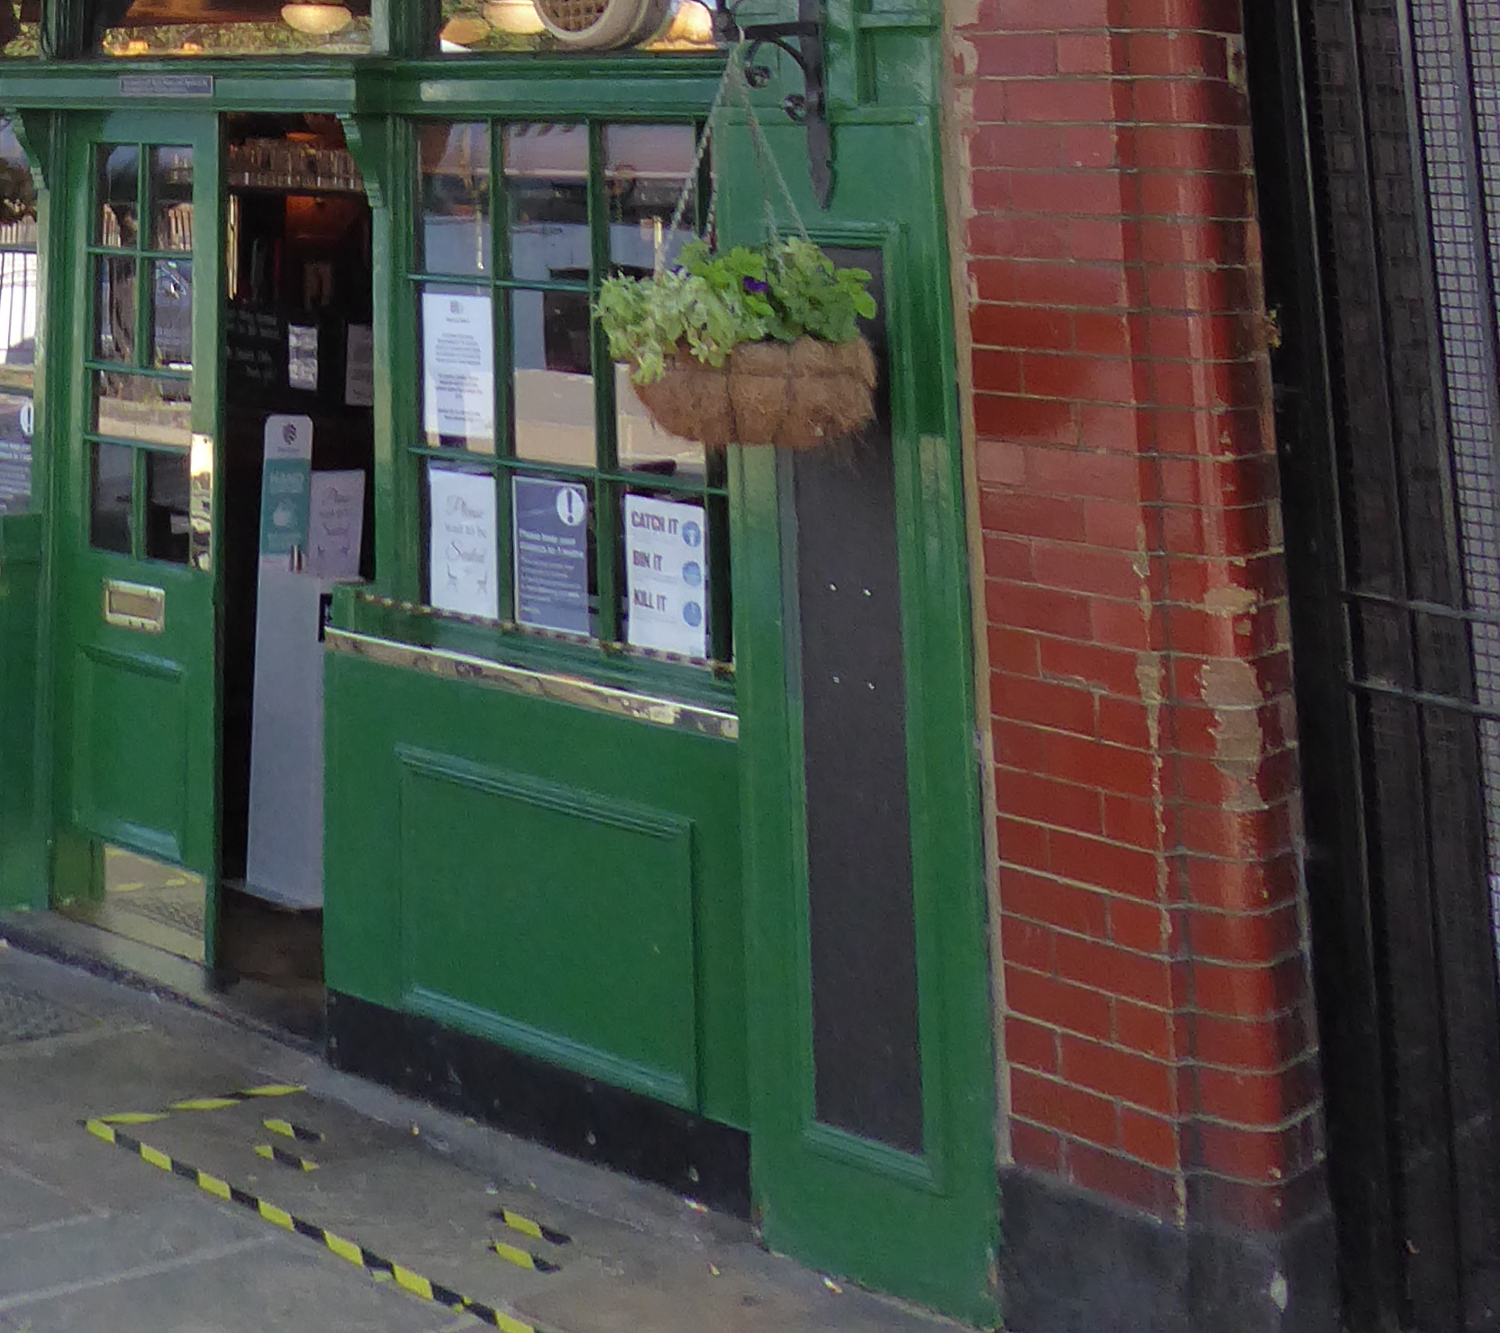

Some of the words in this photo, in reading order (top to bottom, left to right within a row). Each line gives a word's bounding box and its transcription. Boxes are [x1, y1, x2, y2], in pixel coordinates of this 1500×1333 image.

[631, 511, 665, 533] CATCH
[668, 518, 679, 535] IT
[632, 550, 650, 569] BIN
[653, 553, 663, 572] IT
[633, 588, 655, 610] KILL
[656, 594, 668, 613] IT
